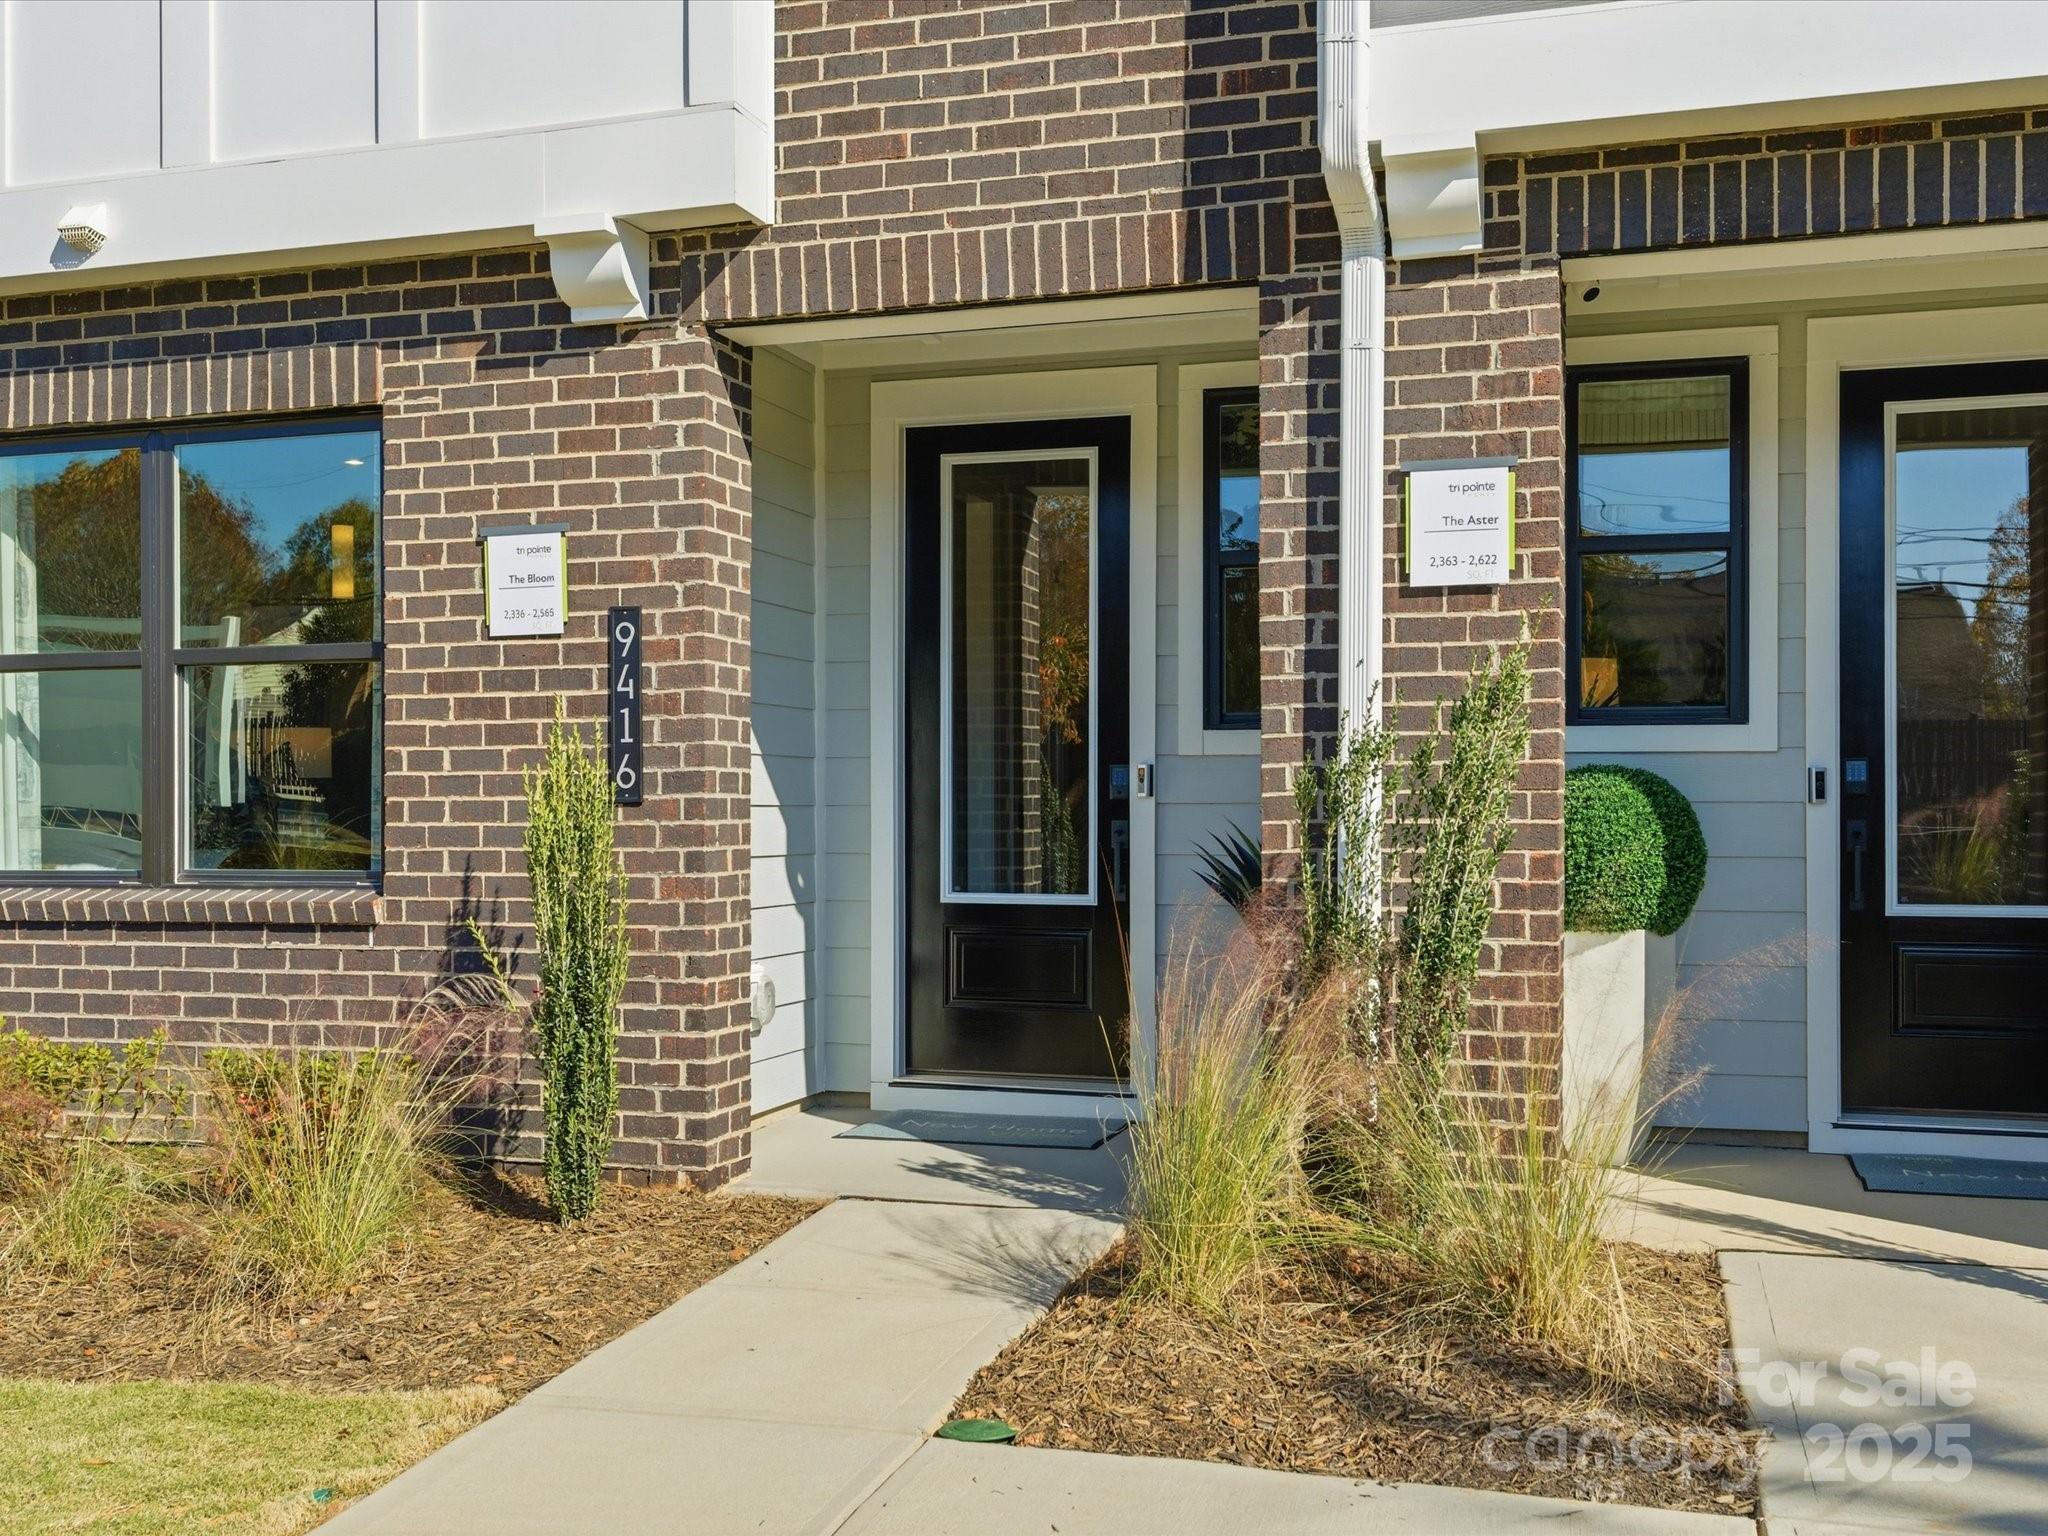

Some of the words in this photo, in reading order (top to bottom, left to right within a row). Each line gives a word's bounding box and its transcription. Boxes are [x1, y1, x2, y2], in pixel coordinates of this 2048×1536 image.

[1448, 484, 1460, 493] tri
[1462, 482, 1496, 495] pointe
[1442, 516, 1464, 527] The
[1467, 515, 1499, 526] Aster
[527, 545, 552, 556] pointe
[1430, 556, 1458, 568] 2,363
[1469, 554, 1498, 567] 2,622
[508, 575, 526, 584] The
[527, 573, 555, 584] Bloom
[504, 610, 525, 620] 2,336
[533, 608, 554, 619] 2,565
[615, 621, 636, 789] 9416
